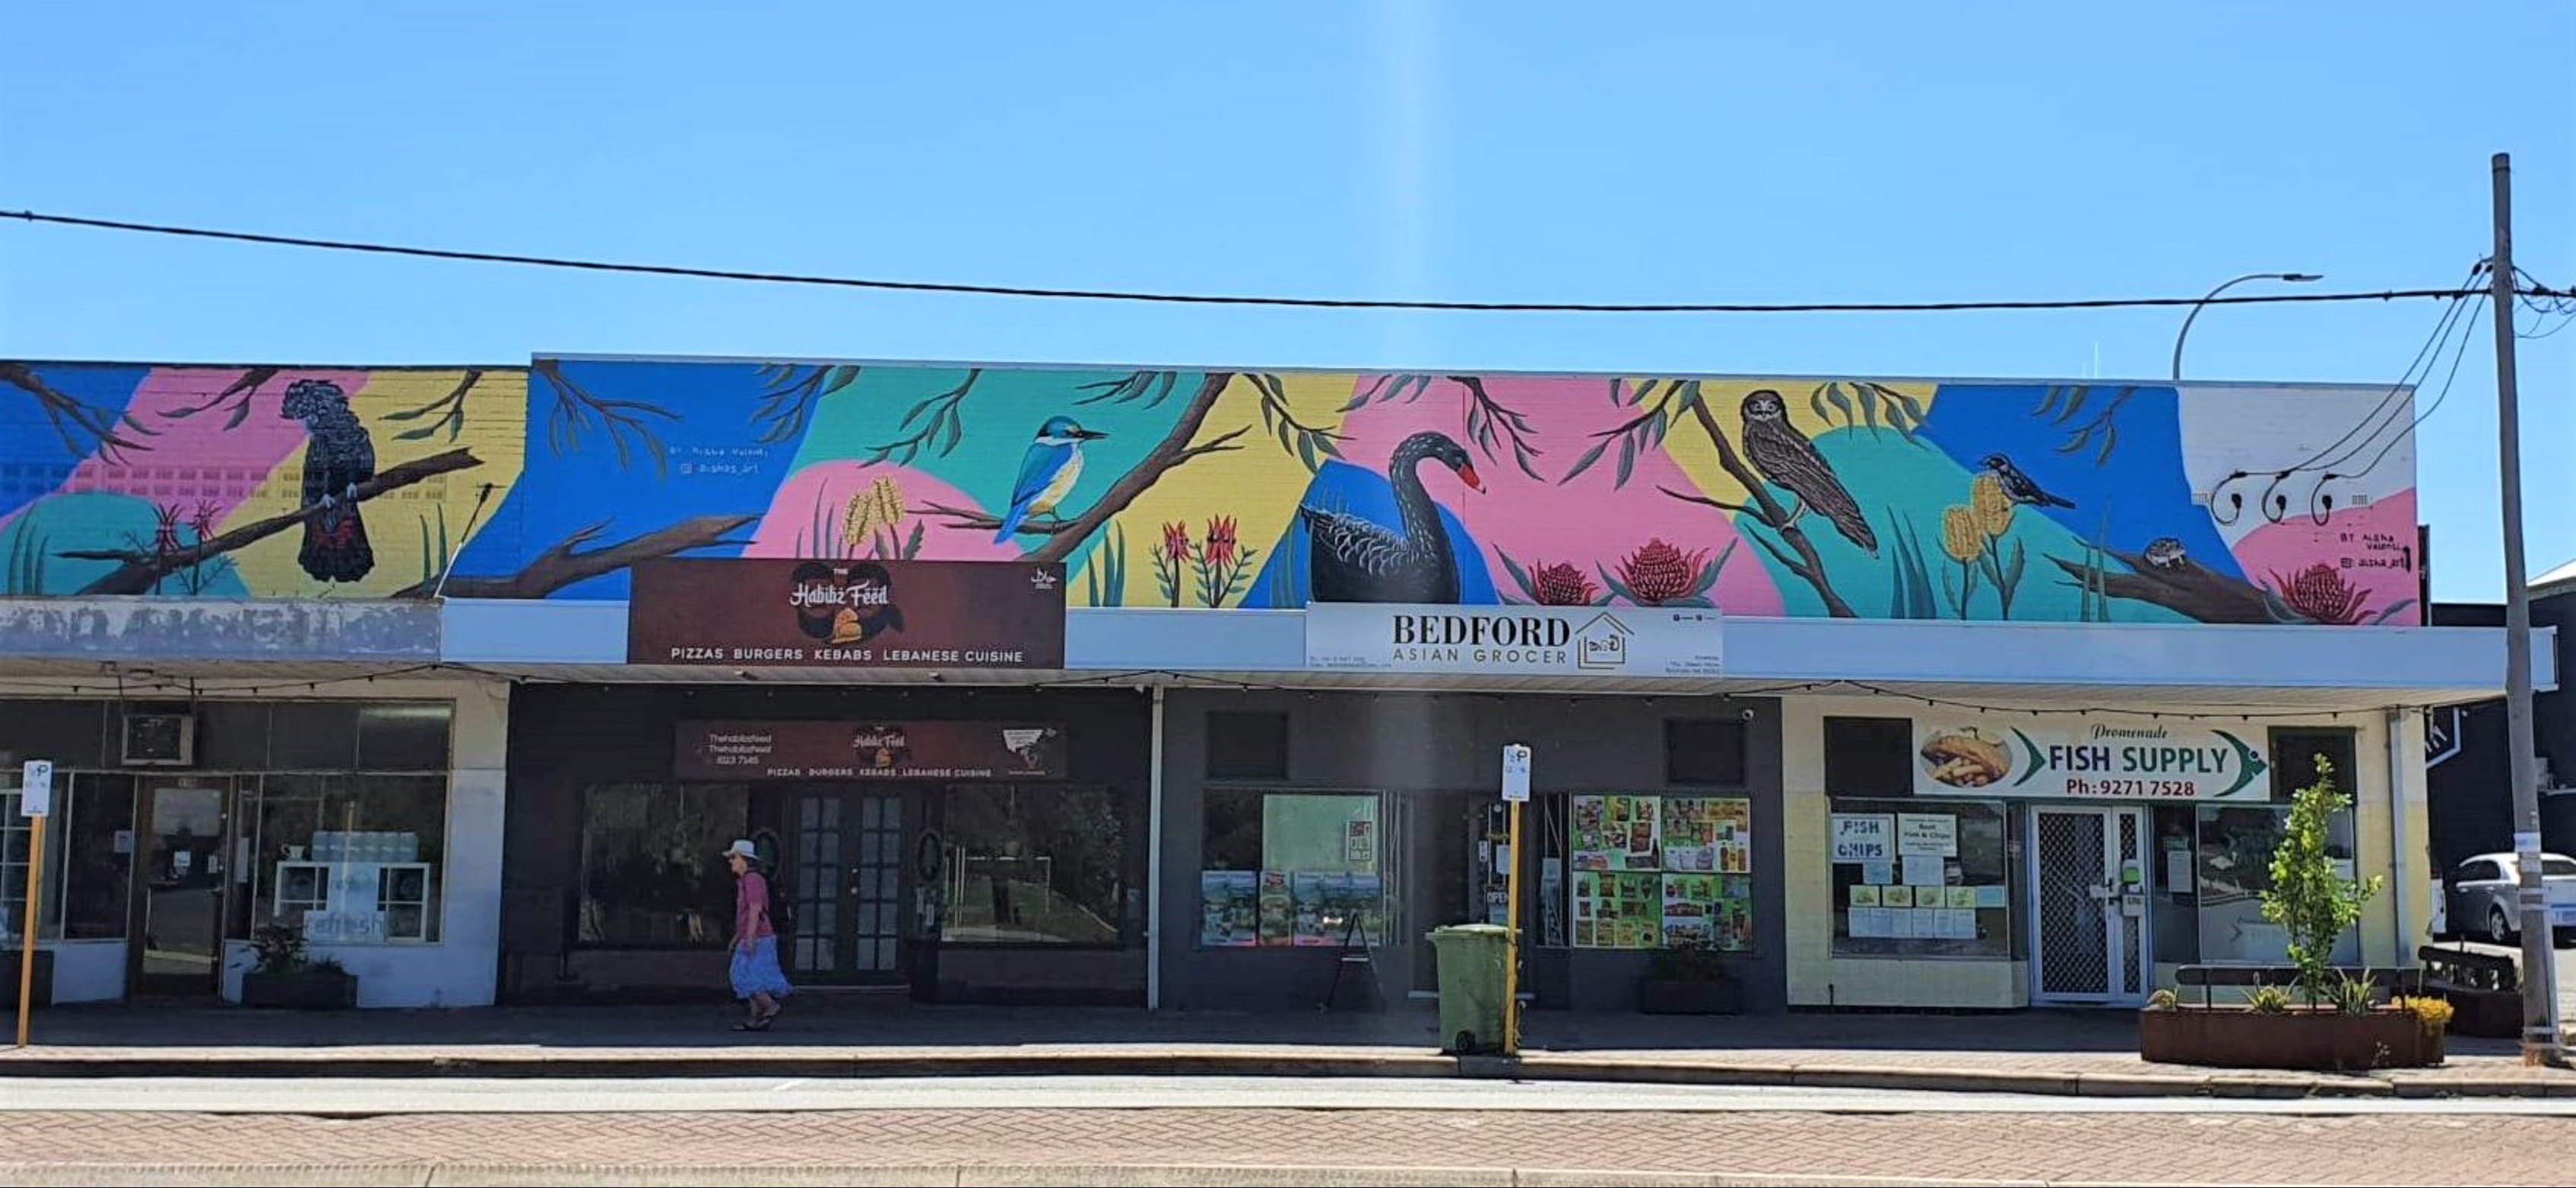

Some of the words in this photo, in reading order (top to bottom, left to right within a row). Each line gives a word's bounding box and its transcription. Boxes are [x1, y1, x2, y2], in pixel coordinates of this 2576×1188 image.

[1392, 614, 1572, 647] BEDFORD
[671, 647, 724, 660] PIZZAS
[733, 648, 804, 661] BURGERS
[814, 649, 872, 662] KEBABS
[883, 650, 960, 663] LEBANESE
[965, 651, 1023, 663] CUISINE
[1393, 648, 1459, 662] ASIAN
[1474, 649, 1568, 665] GROCER
[2089, 723, 2168, 741] Promenade
[2049, 744, 2111, 772] FISH
[2122, 746, 2229, 774] SUPPLY
[2101, 780, 2144, 795] 9271
[2149, 781, 2195, 797] 7528
[1838, 843, 1883, 857] CHIPS
